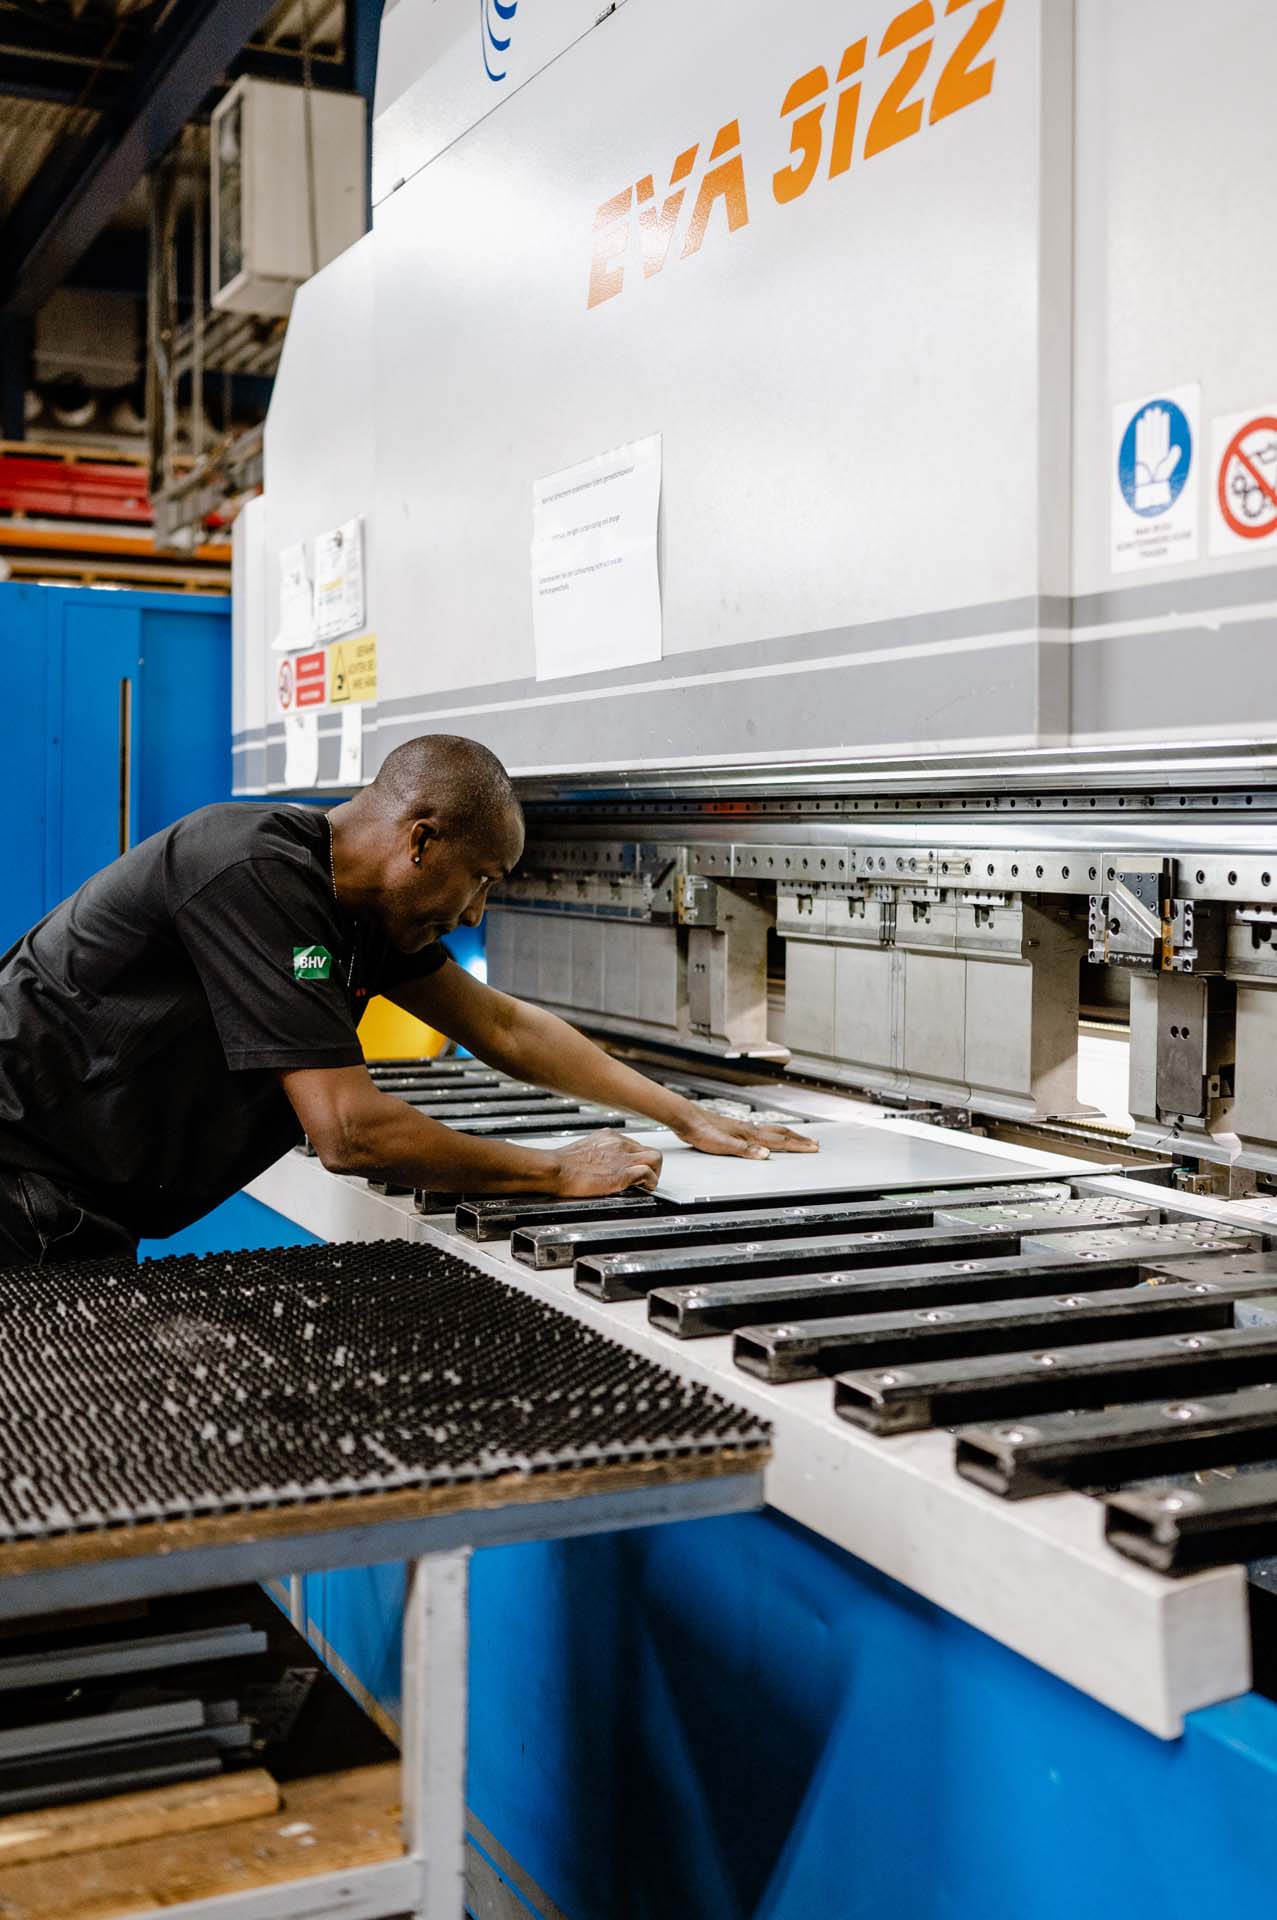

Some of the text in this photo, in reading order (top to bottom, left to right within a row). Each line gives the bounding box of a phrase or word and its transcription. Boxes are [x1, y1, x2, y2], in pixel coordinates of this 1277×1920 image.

[587, 0, 1005, 310] EVA 3122
[300, 956, 327, 969] BHV
